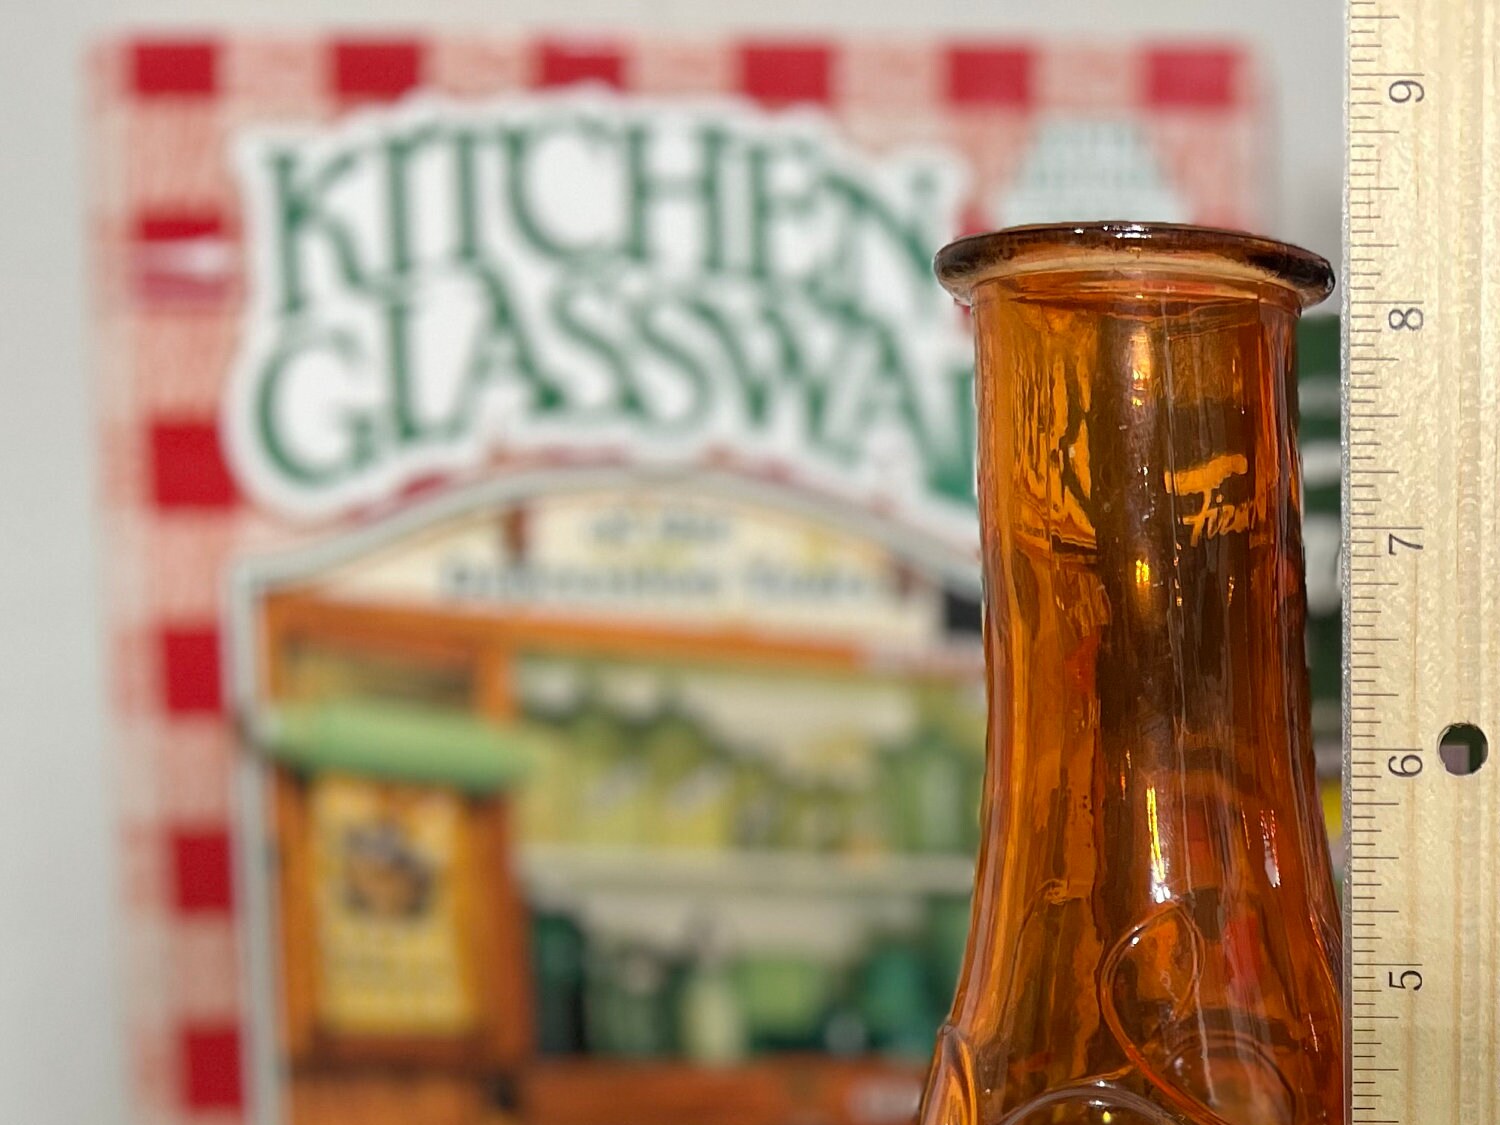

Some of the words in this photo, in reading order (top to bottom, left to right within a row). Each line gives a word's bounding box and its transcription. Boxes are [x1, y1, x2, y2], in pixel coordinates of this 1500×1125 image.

[1388, 79, 1425, 104] 9
[265, 113, 942, 312] KITCHEN
[1388, 308, 1424, 332] 8
[255, 258, 976, 505] GLASSWA
[1388, 533, 1424, 557] 7
[1388, 754, 1423, 778] 6
[1388, 970, 1423, 992] 5
